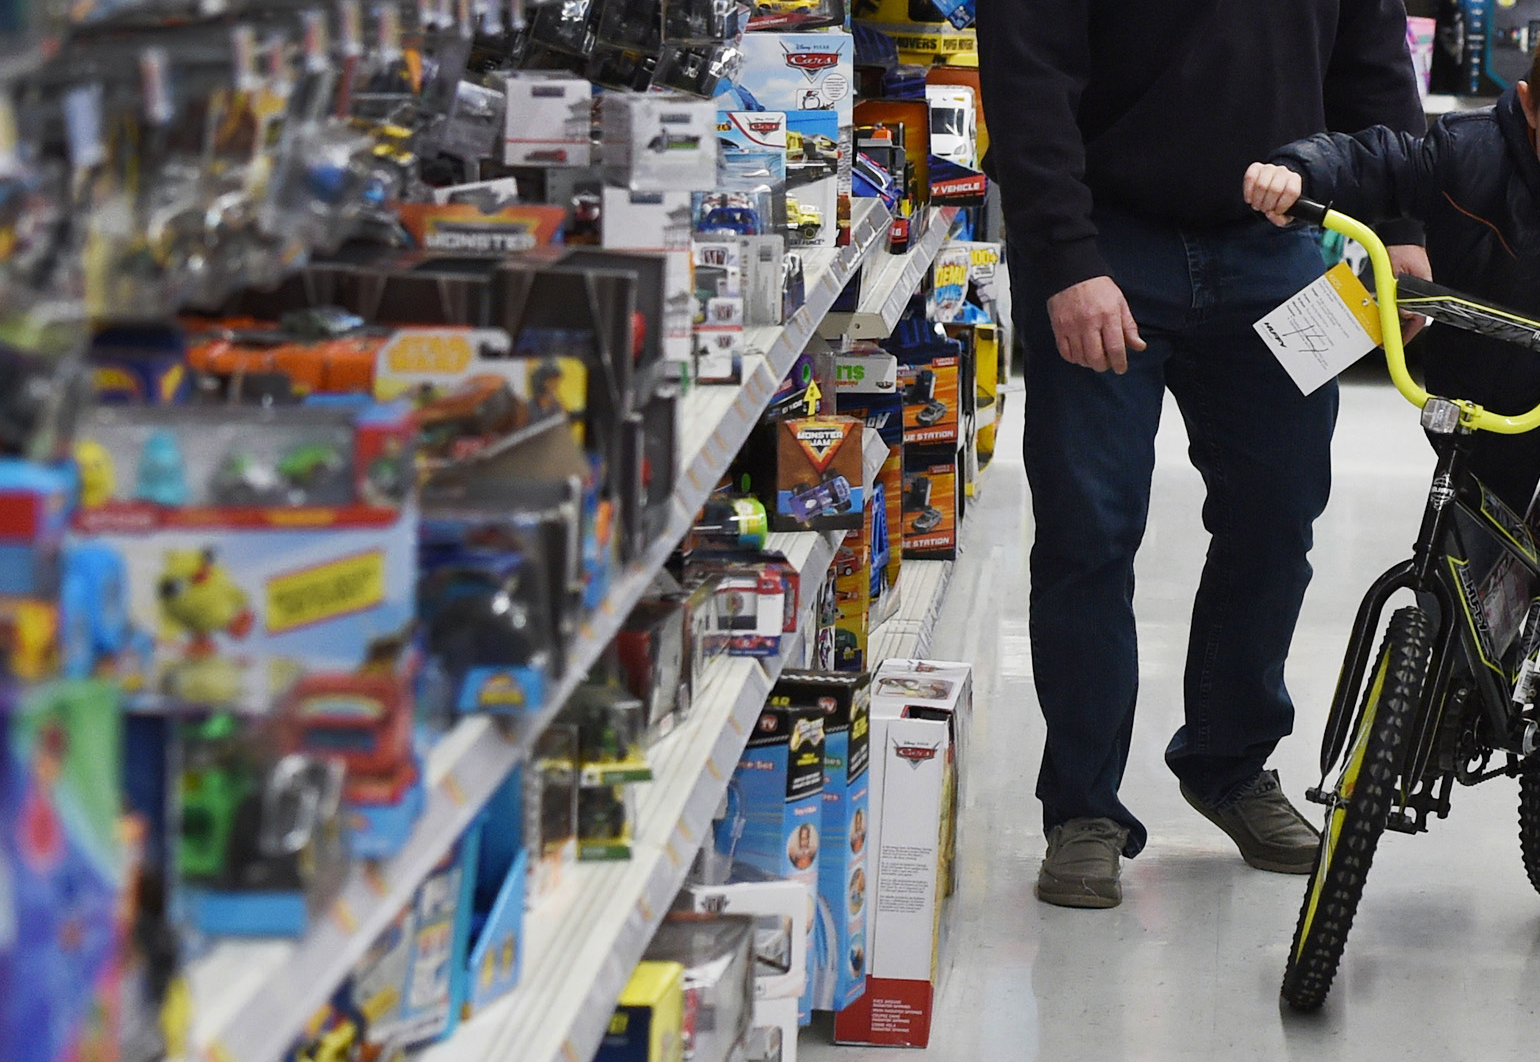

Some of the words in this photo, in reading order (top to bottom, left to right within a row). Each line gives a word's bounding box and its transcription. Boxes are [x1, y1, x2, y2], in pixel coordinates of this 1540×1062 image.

[790, 54, 833, 66] Cars
[941, 182, 980, 194] VEHICLE
[969, 249, 999, 267] 100+
[935, 264, 967, 288] DEMO
[1263, 322, 1287, 348] HUFFY
[797, 431, 843, 440] MONSTER
[920, 429, 954, 441] STATION
[810, 438, 831, 447] JAM
[912, 537, 950, 548] STATION
